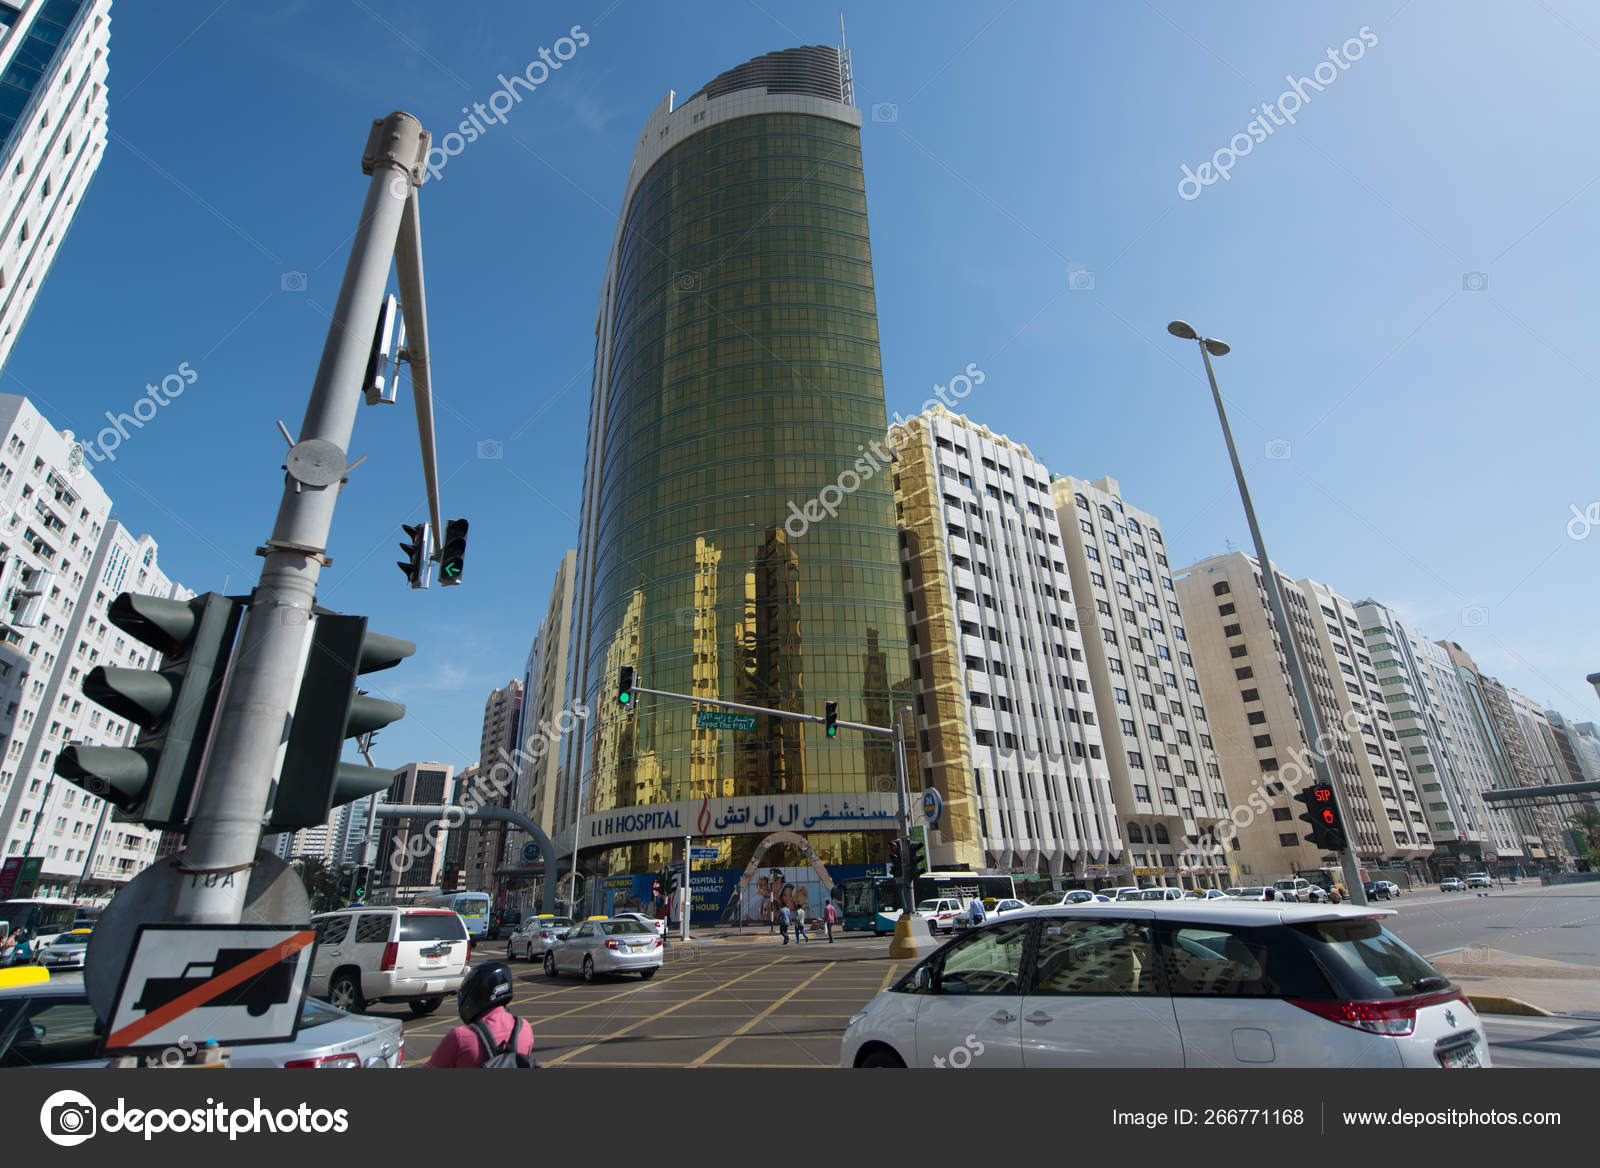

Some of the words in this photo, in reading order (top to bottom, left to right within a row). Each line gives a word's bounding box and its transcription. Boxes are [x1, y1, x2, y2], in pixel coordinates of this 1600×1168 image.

[1314, 789, 1331, 801] STP
[616, 810, 681, 832] HOSPITAL
[691, 885, 723, 893] HARMACY
